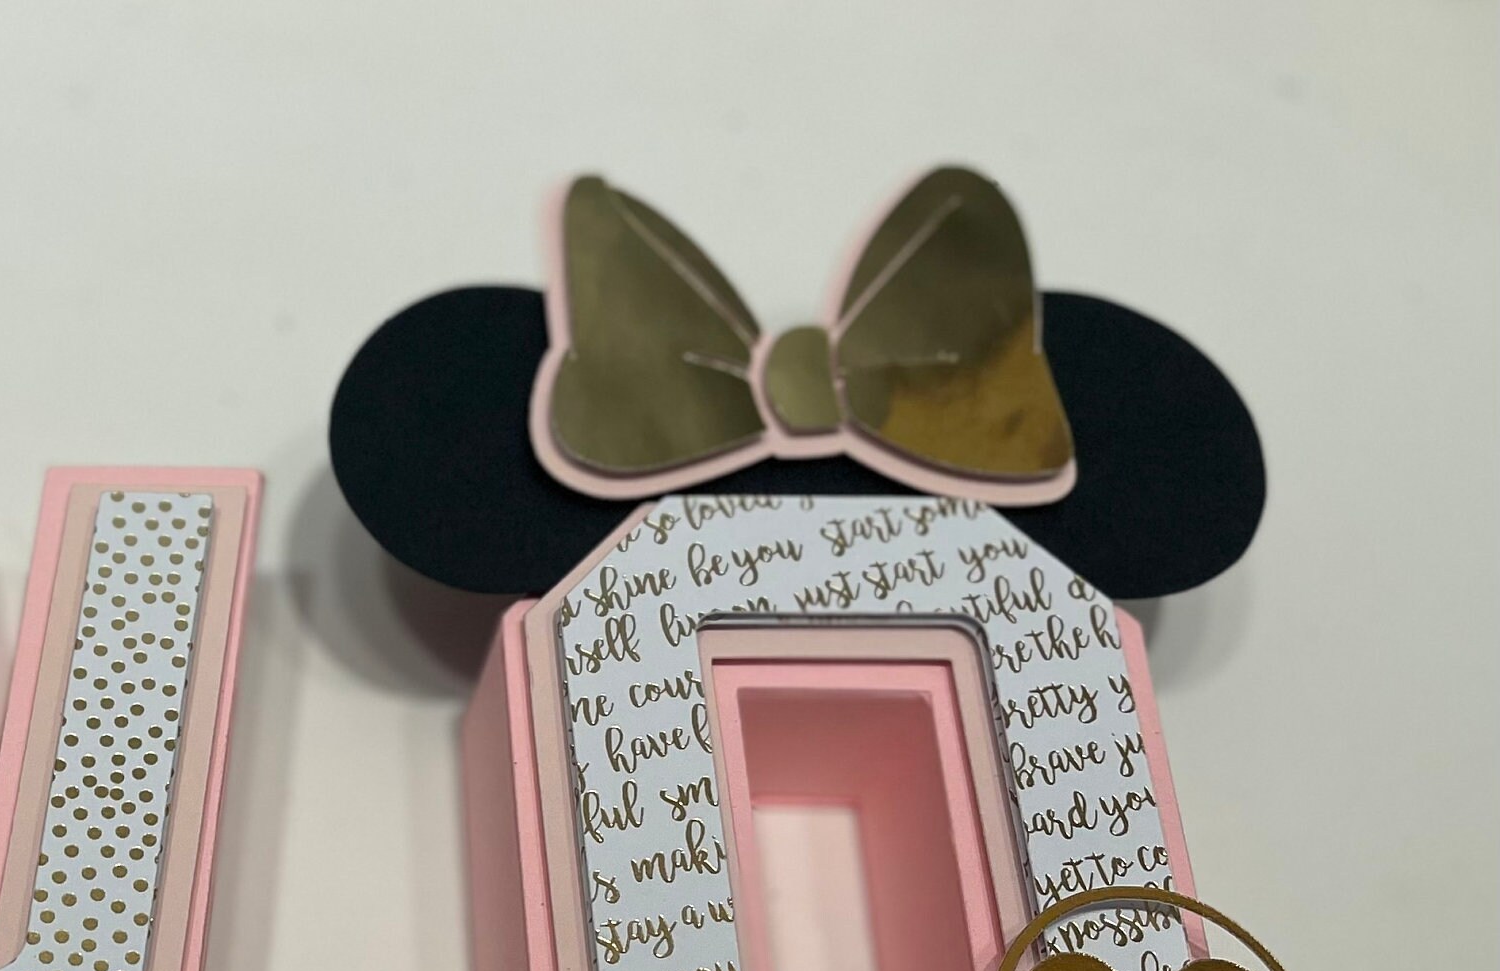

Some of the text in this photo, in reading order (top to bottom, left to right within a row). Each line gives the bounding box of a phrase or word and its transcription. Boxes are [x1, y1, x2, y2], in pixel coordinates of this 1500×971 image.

[583, 564, 677, 618] shine
[687, 541, 729, 587] be
[731, 538, 804, 587] you
[819, 506, 903, 557] start
[861, 549, 945, 600] start
[958, 537, 1030, 583] you
[1024, 614, 1091, 661] the
[605, 725, 691, 774] have
[1024, 790, 1099, 841] ard
[1084, 851, 1134, 887] to
[594, 912, 678, 965] stay
